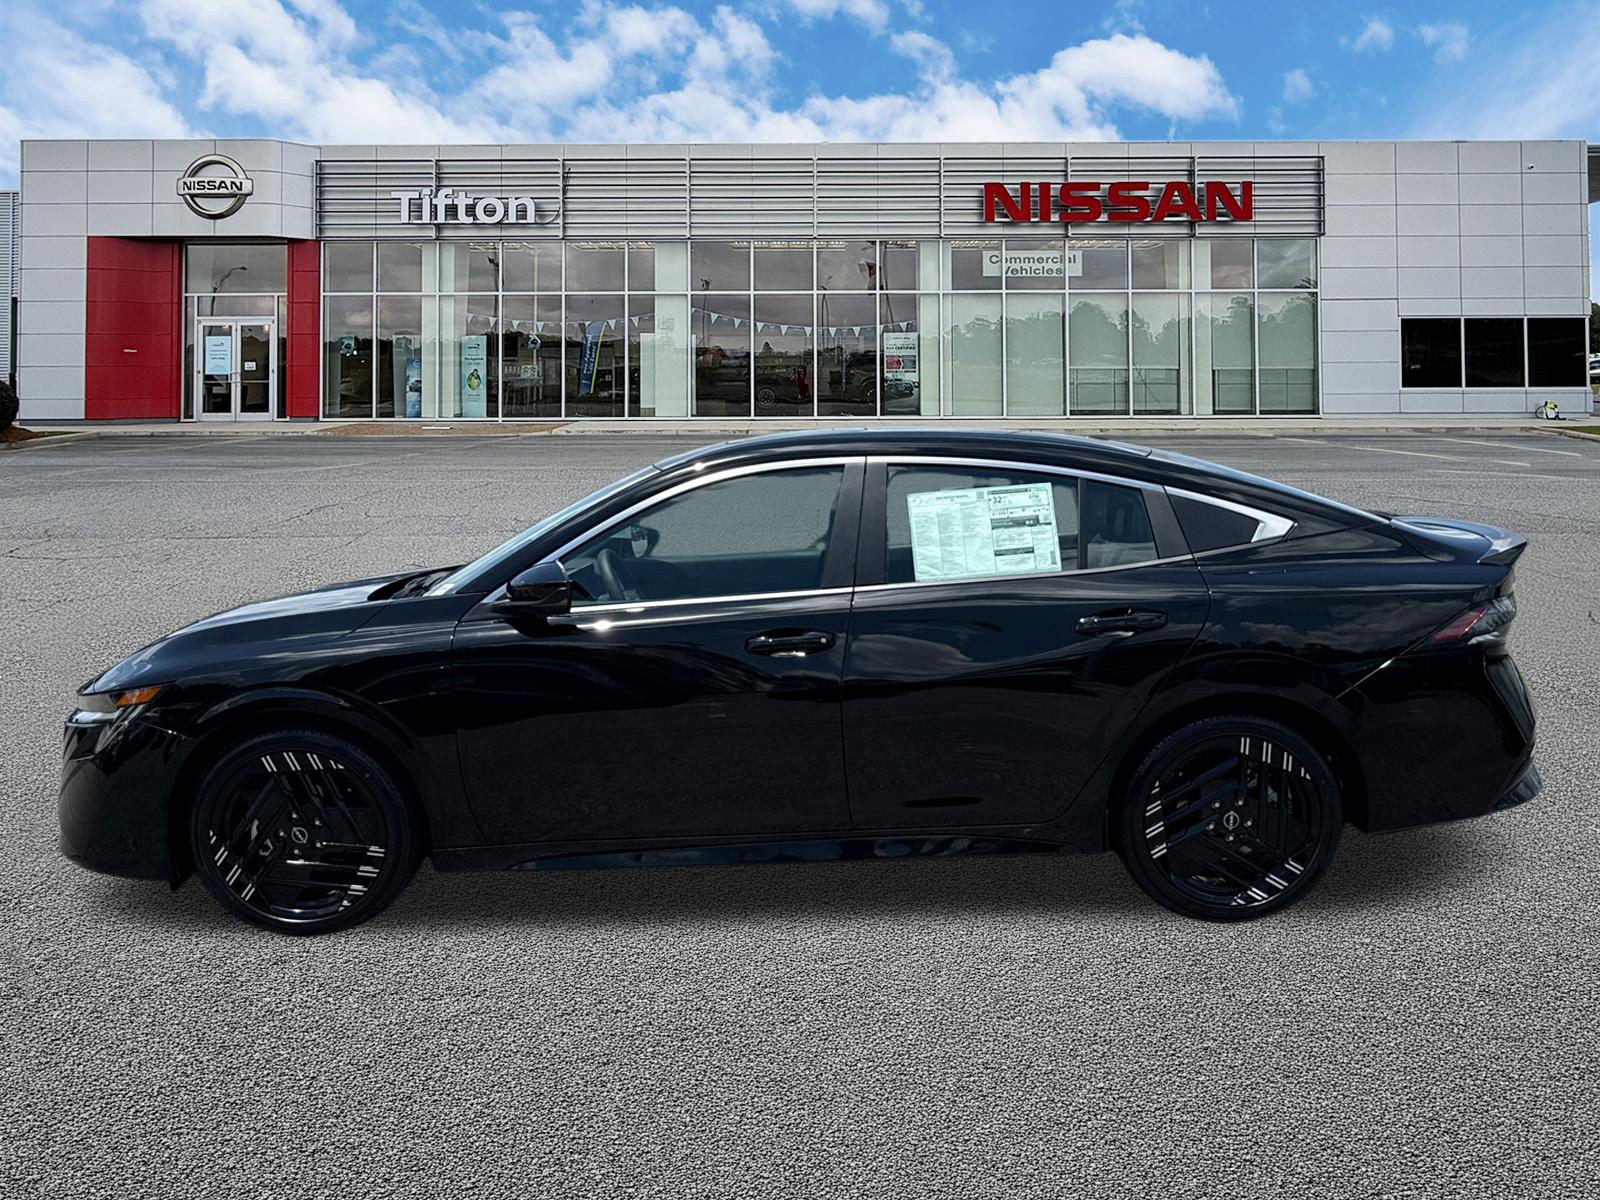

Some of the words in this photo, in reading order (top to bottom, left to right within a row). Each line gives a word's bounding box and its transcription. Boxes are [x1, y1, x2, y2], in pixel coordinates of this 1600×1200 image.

[182, 180, 243, 191] NISSAN
[983, 181, 1253, 222] NISSAN
[390, 188, 536, 224] Tifton
